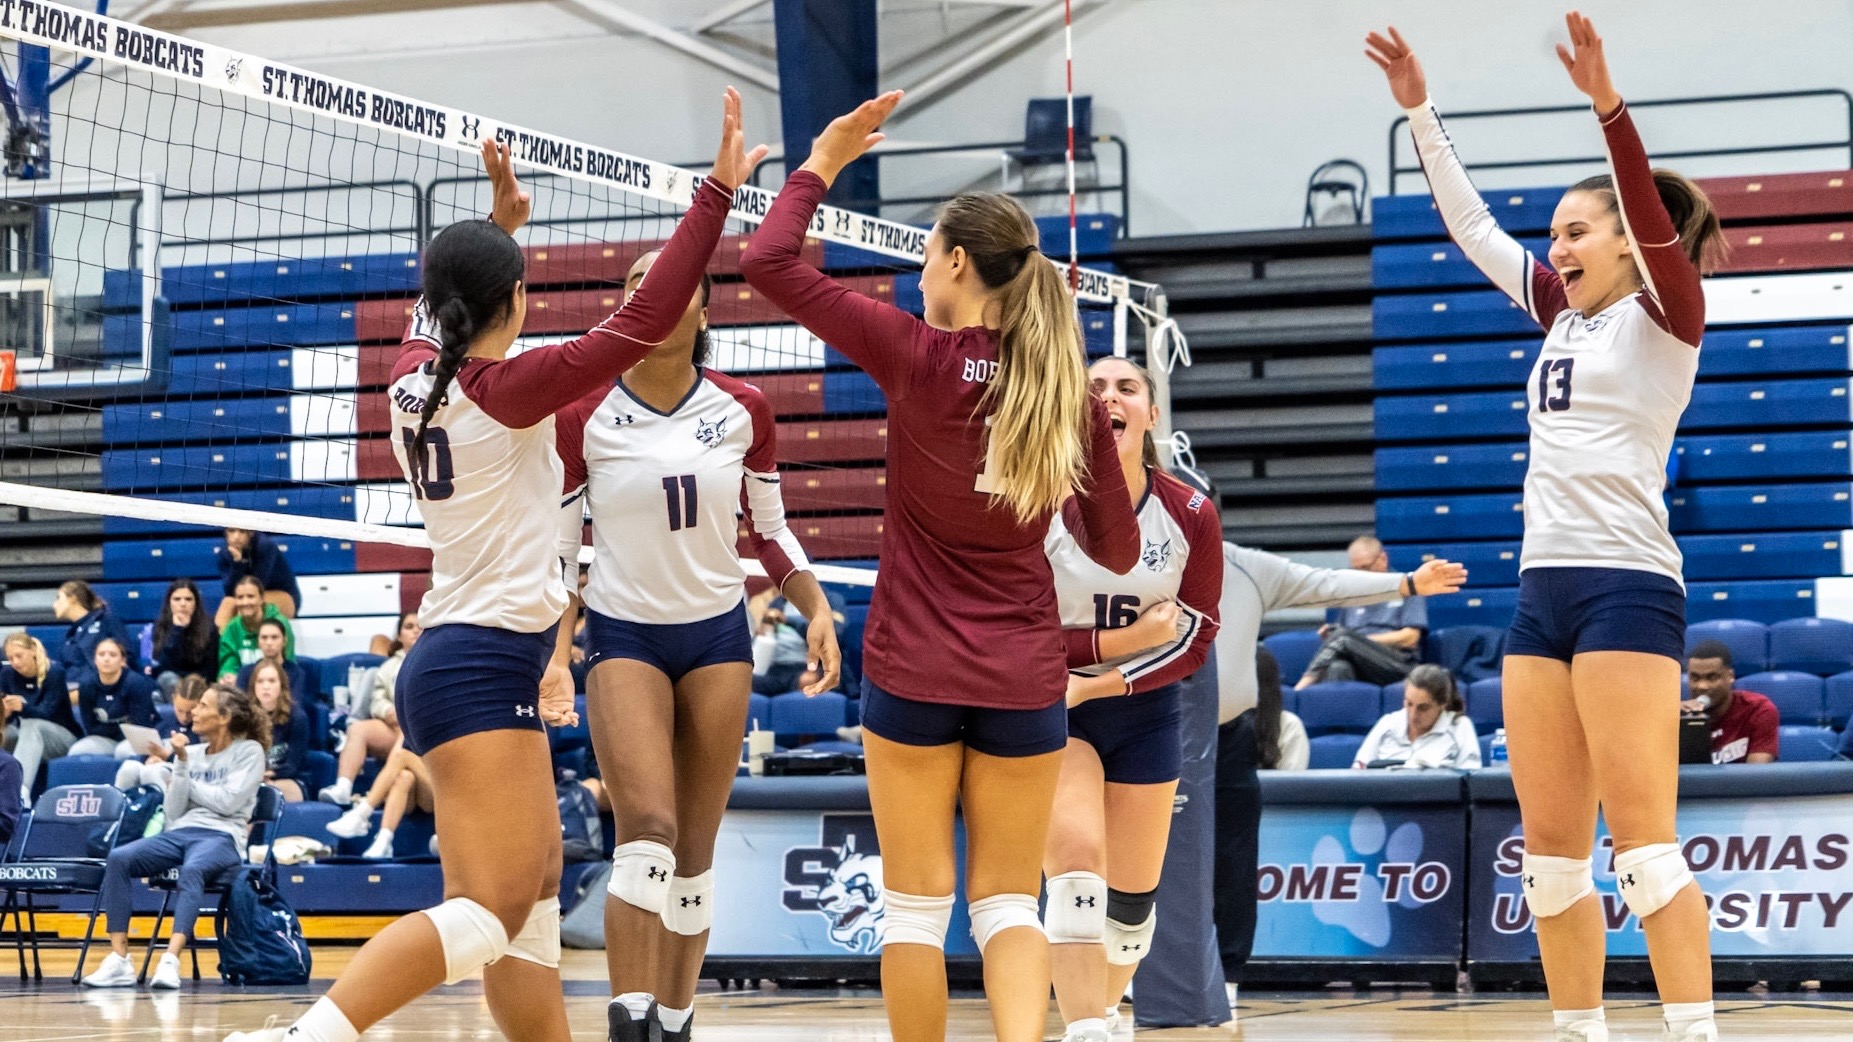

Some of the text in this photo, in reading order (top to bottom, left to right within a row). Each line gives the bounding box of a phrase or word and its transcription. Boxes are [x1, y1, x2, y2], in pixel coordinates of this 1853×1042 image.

[115, 26, 204, 78] BOBCATS
[371, 94, 446, 139] BOBCATS
[586, 150, 650, 189] BOBCATS
[1539, 357, 1575, 413] 13
[402, 426, 455, 501] 10
[662, 474, 698, 531] 11
[1093, 593, 1141, 629] 16
[56, 789, 102, 817] STU
[0, 867, 57, 880] BOBCATS
[1379, 861, 1451, 903] TO
